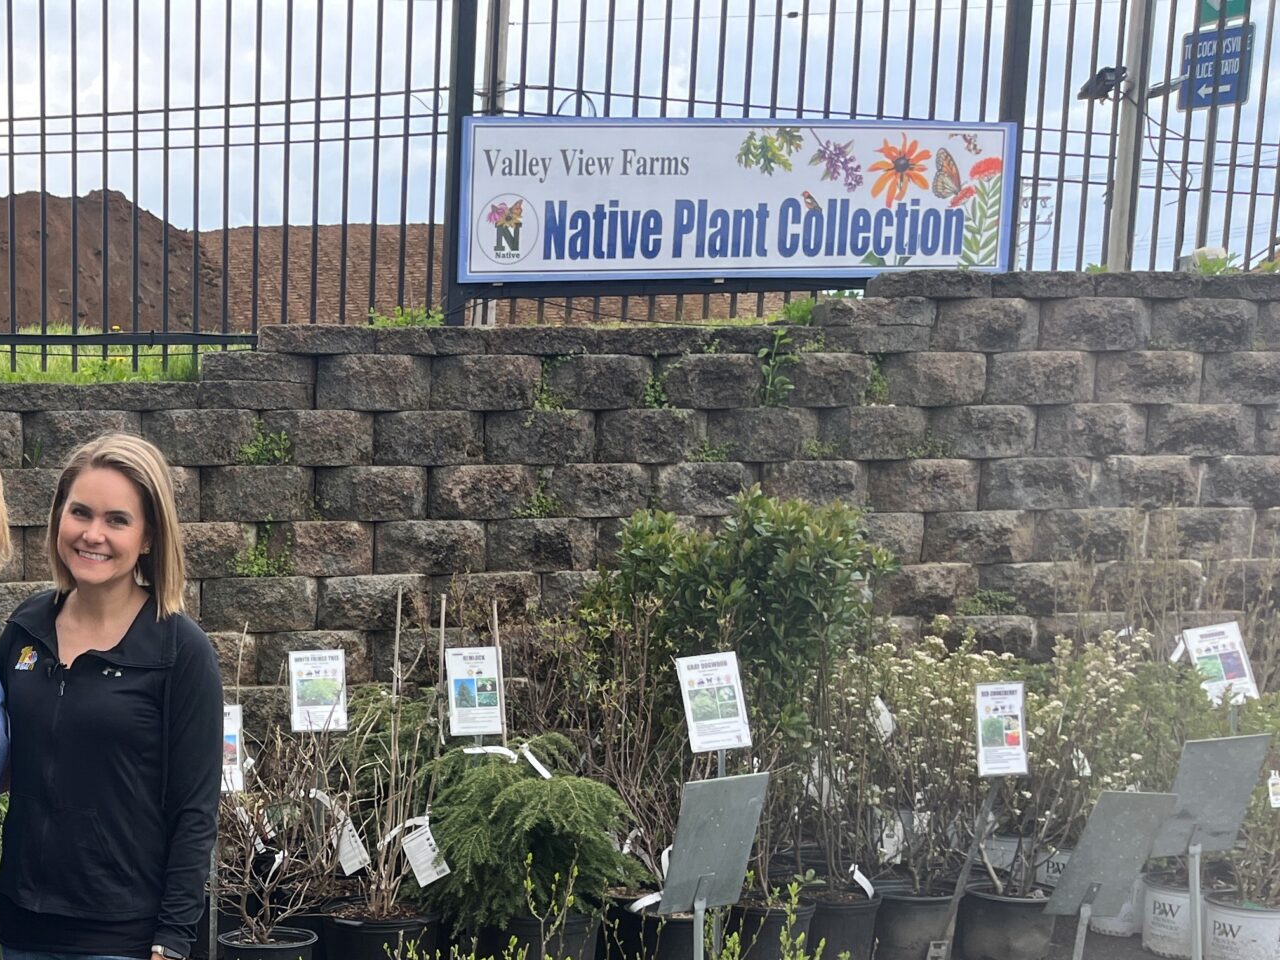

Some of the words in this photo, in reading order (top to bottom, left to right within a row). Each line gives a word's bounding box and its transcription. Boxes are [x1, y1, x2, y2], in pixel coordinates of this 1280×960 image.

[1195, 62, 1214, 78] LICE
[1220, 58, 1240, 75] TATIO
[483, 148, 552, 183] Valley
[560, 148, 615, 176] View
[620, 148, 690, 176] Farms
[543, 200, 662, 261] Native
[672, 199, 769, 259] Plant
[777, 197, 965, 258] Collection
